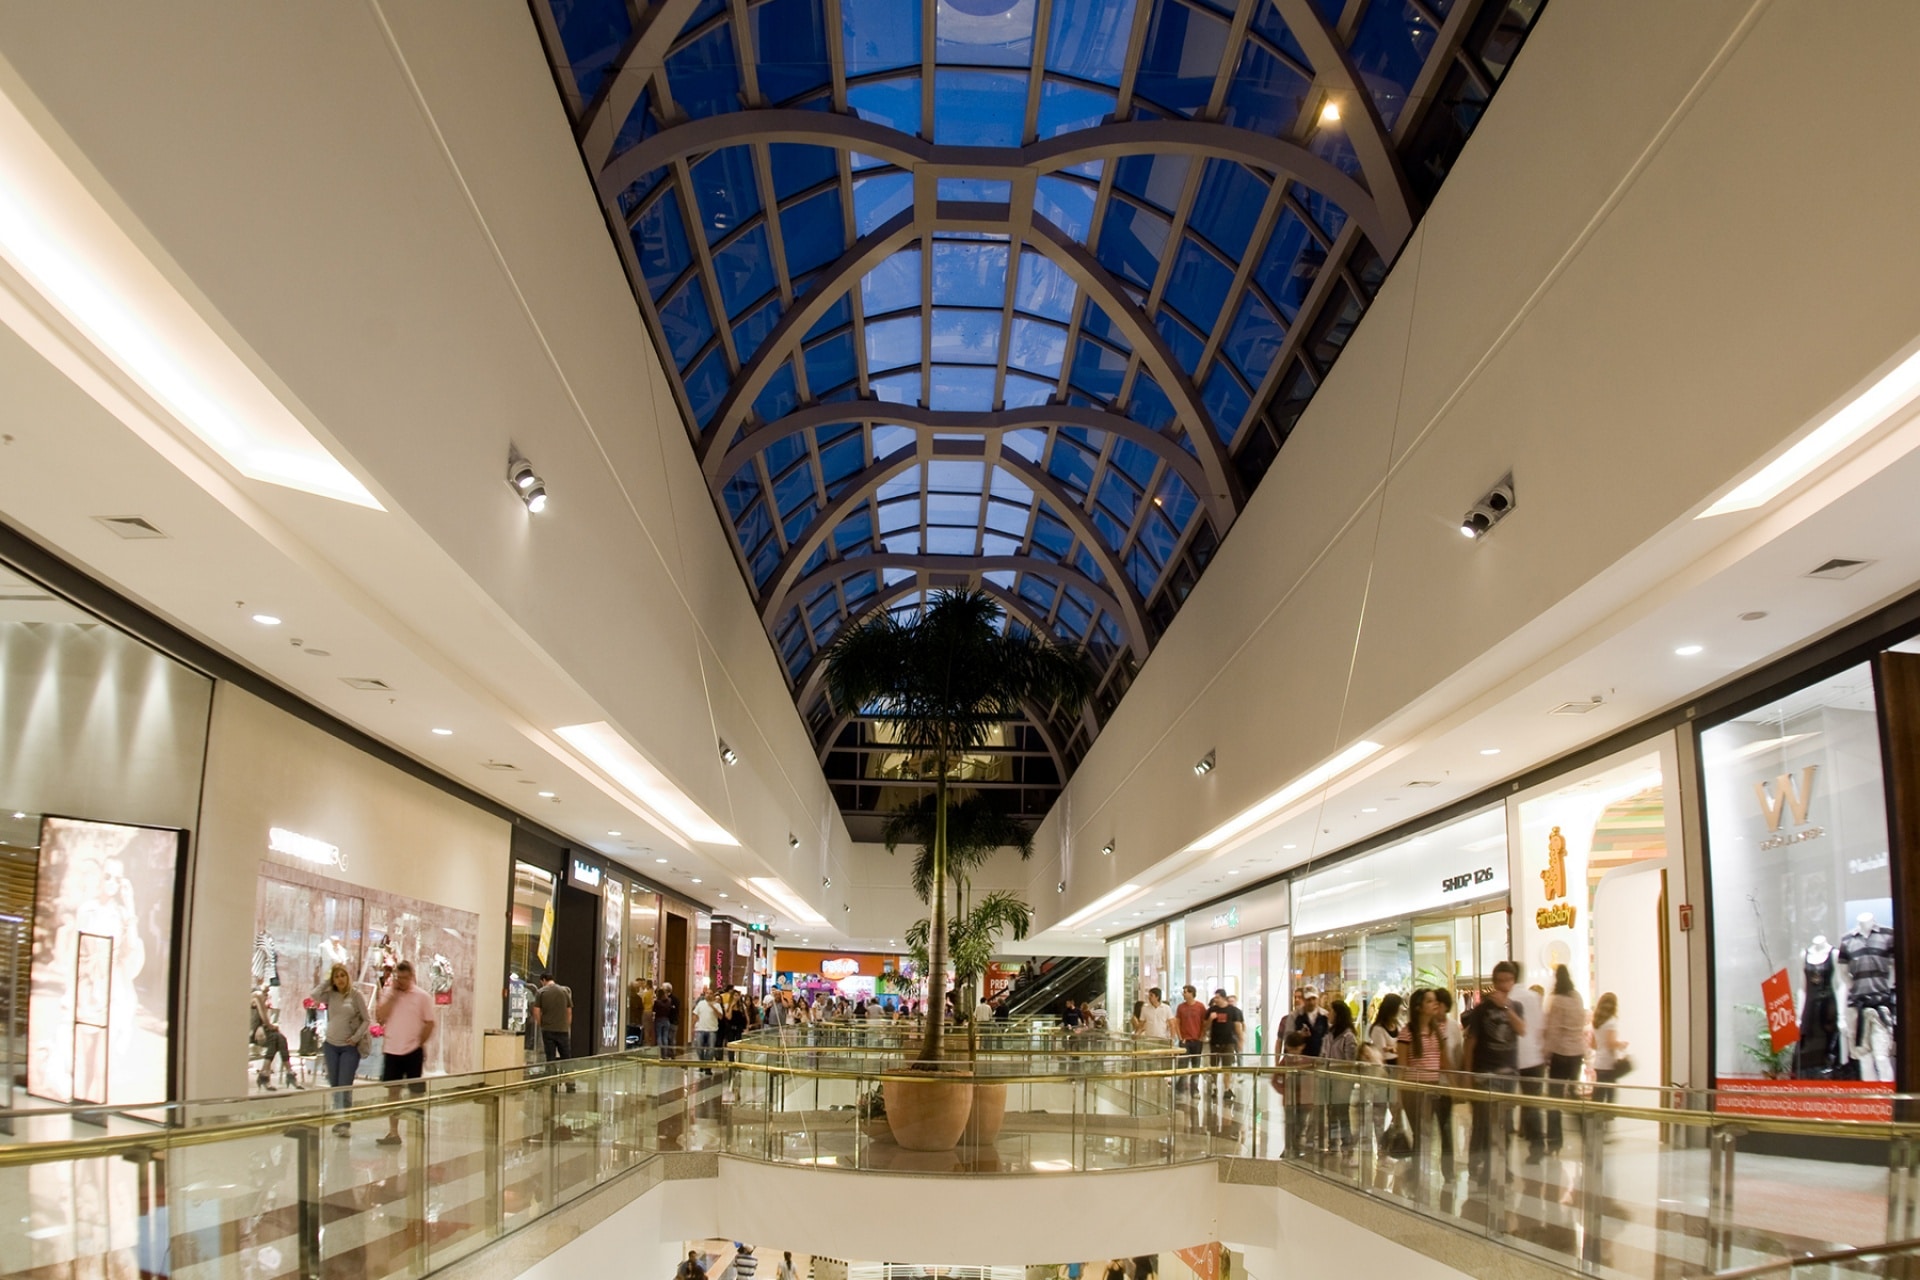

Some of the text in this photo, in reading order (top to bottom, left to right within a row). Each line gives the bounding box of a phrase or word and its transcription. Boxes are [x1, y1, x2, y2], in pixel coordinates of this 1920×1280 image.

[1753, 765, 1819, 833] W
[1442, 867, 1494, 893] SHOP 126
[990, 979, 1009, 990] PREP
[1770, 1007, 1795, 1032] 20%
